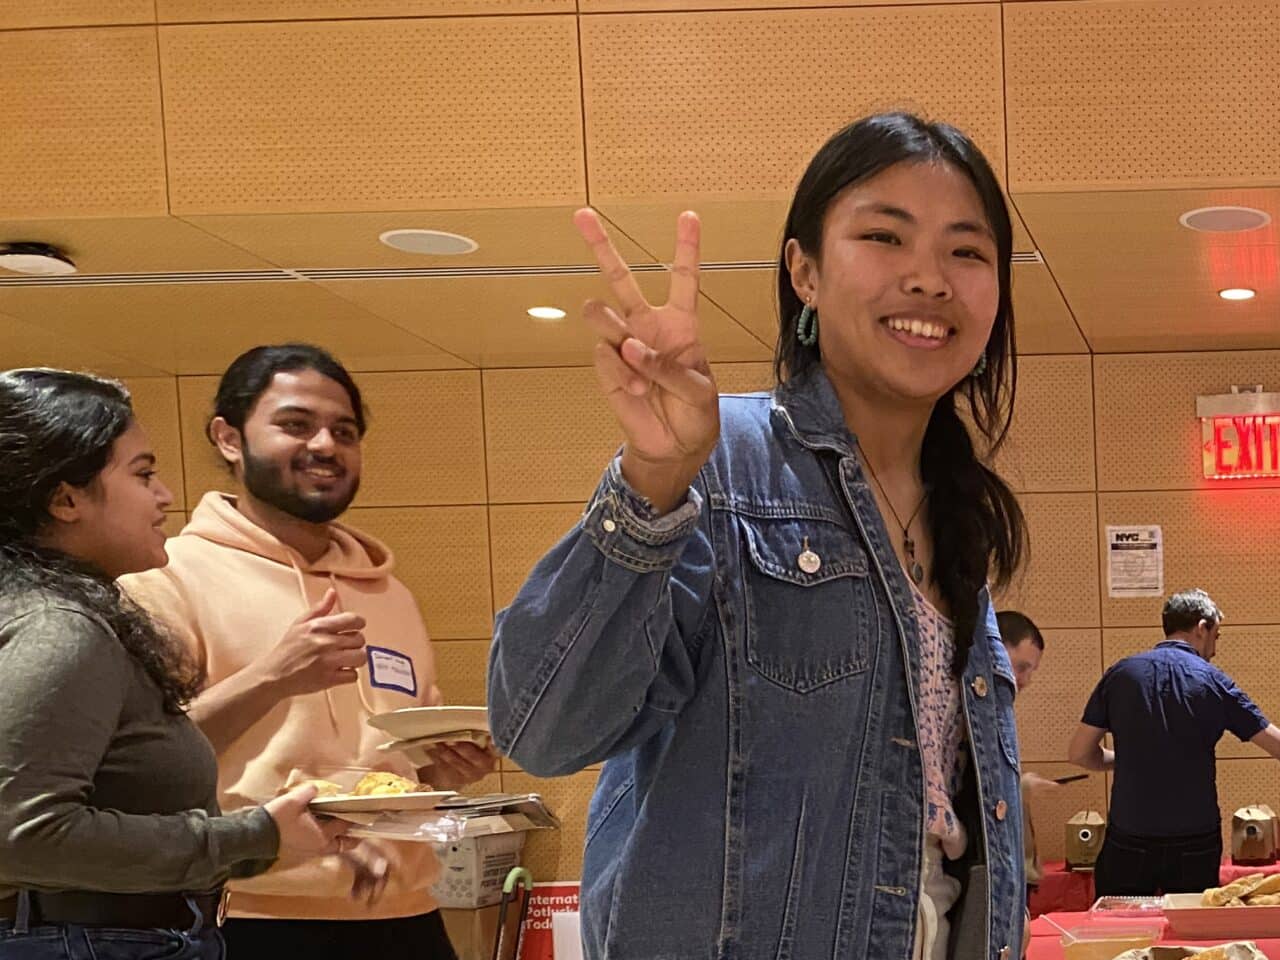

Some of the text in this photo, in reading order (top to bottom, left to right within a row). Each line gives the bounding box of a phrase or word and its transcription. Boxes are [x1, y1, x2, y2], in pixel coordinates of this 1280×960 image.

[1214, 416, 1280, 473] EXIT
[1115, 533, 1140, 542] NYC
[528, 894, 579, 905] nternat
[525, 918, 553, 930] Tod
